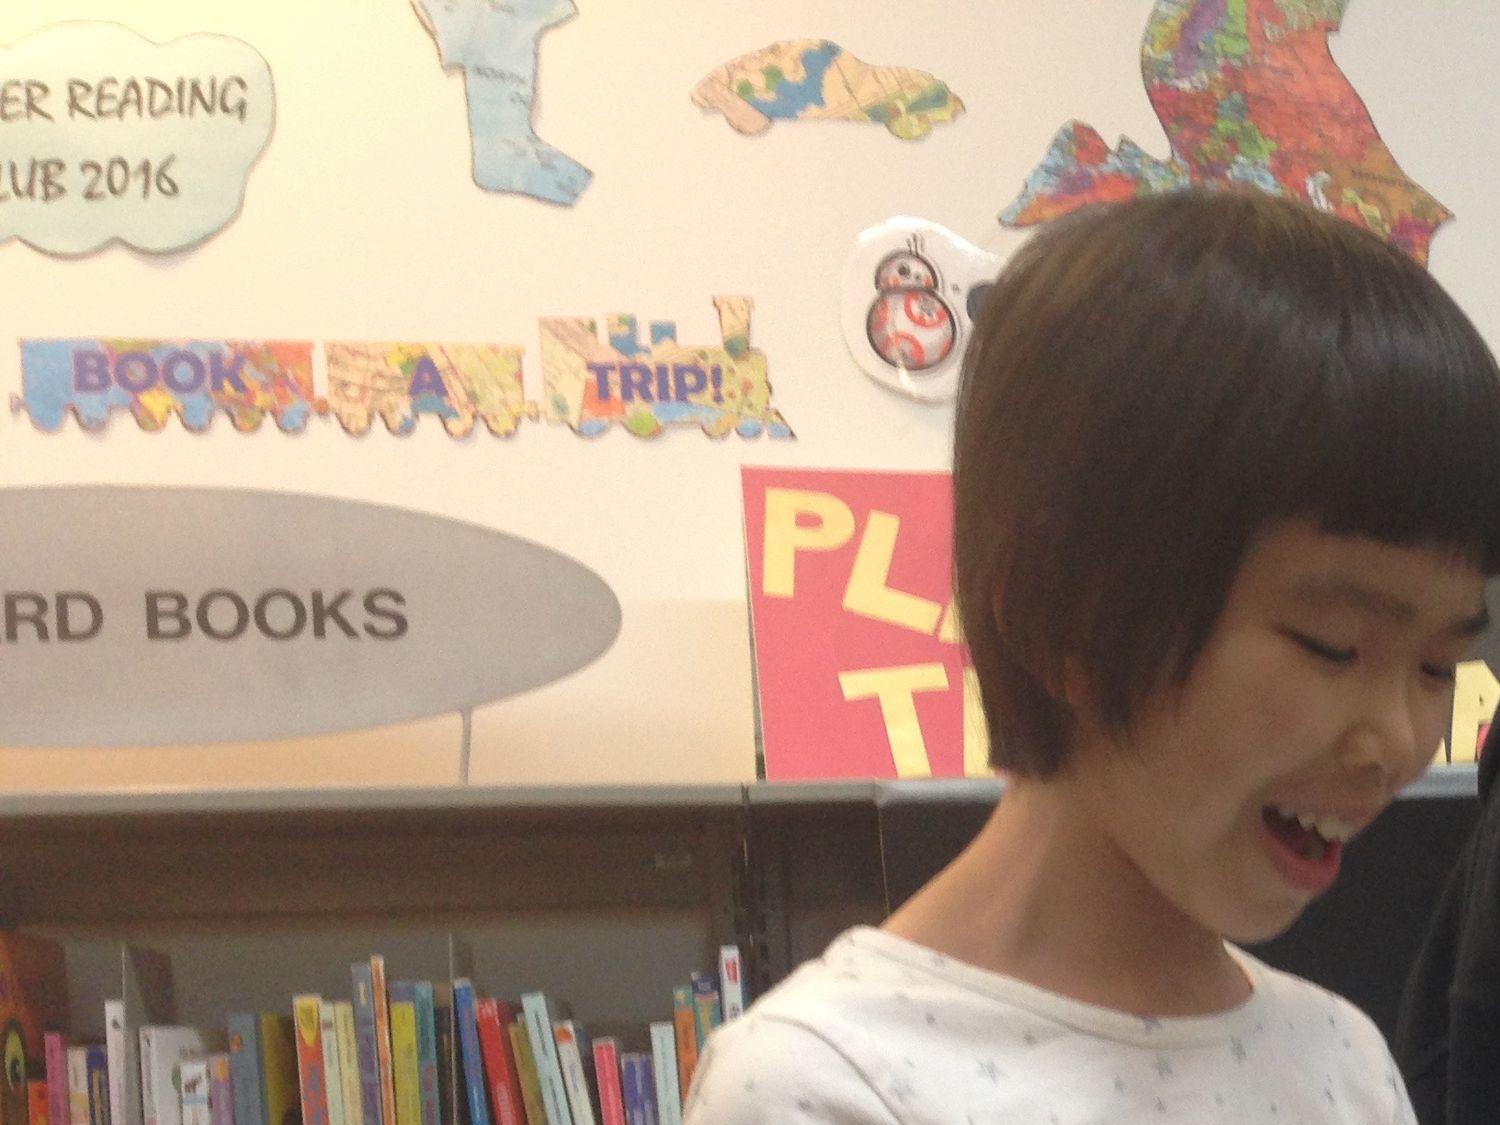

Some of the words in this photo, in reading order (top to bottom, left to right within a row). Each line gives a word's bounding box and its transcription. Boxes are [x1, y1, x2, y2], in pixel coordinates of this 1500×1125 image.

[67, 75, 248, 124] READING
[80, 154, 179, 201] 2016
[72, 350, 250, 394] BOOK
[408, 355, 448, 399] A
[588, 361, 724, 402] TRIP!
[762, 487, 966, 644] PL
[3, 590, 104, 642] RD
[144, 588, 410, 642] BOOKS
